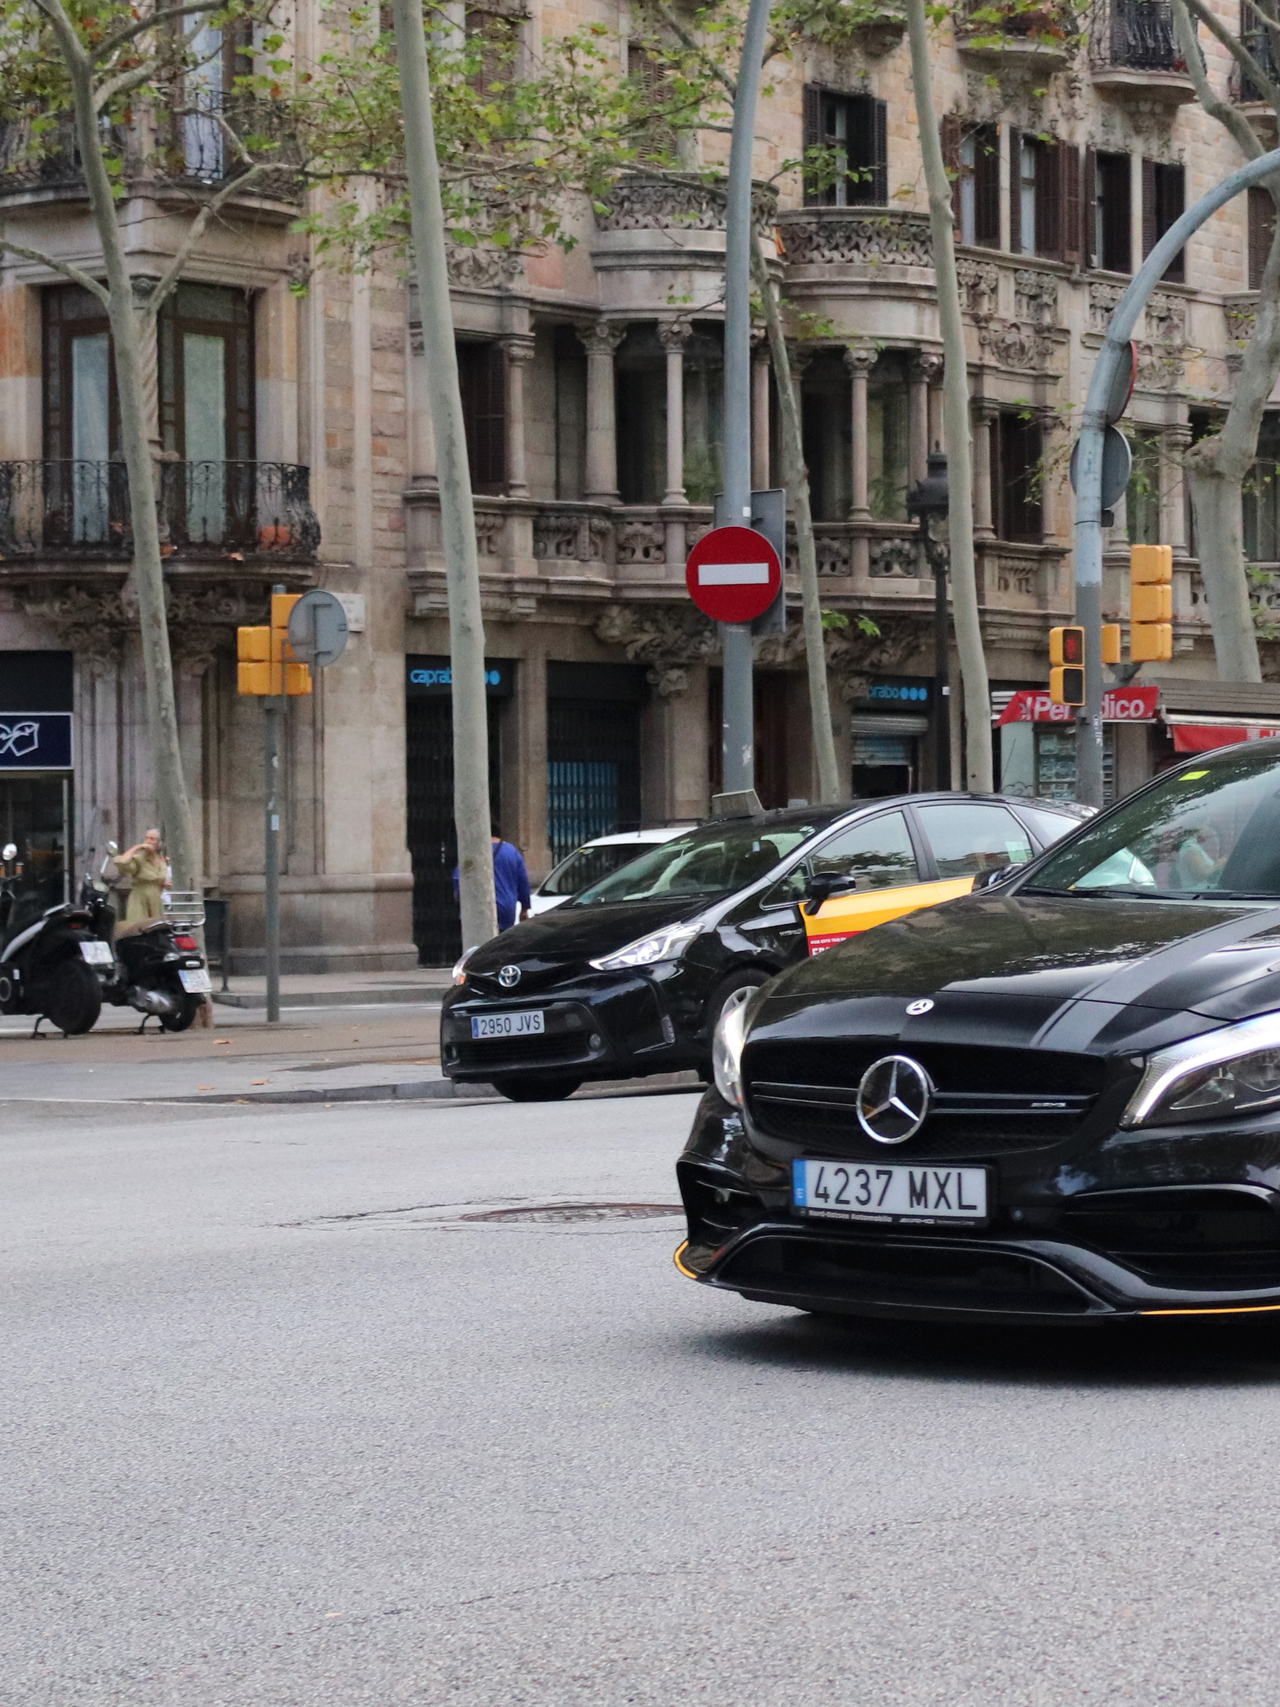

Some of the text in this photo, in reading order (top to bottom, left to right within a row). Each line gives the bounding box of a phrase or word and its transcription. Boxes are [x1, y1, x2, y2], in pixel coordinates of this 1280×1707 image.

[1034, 694, 1145, 721] Perdico
[481, 1015, 541, 1036] 2950 JVS
[814, 1166, 978, 1211] 4237 MXL
